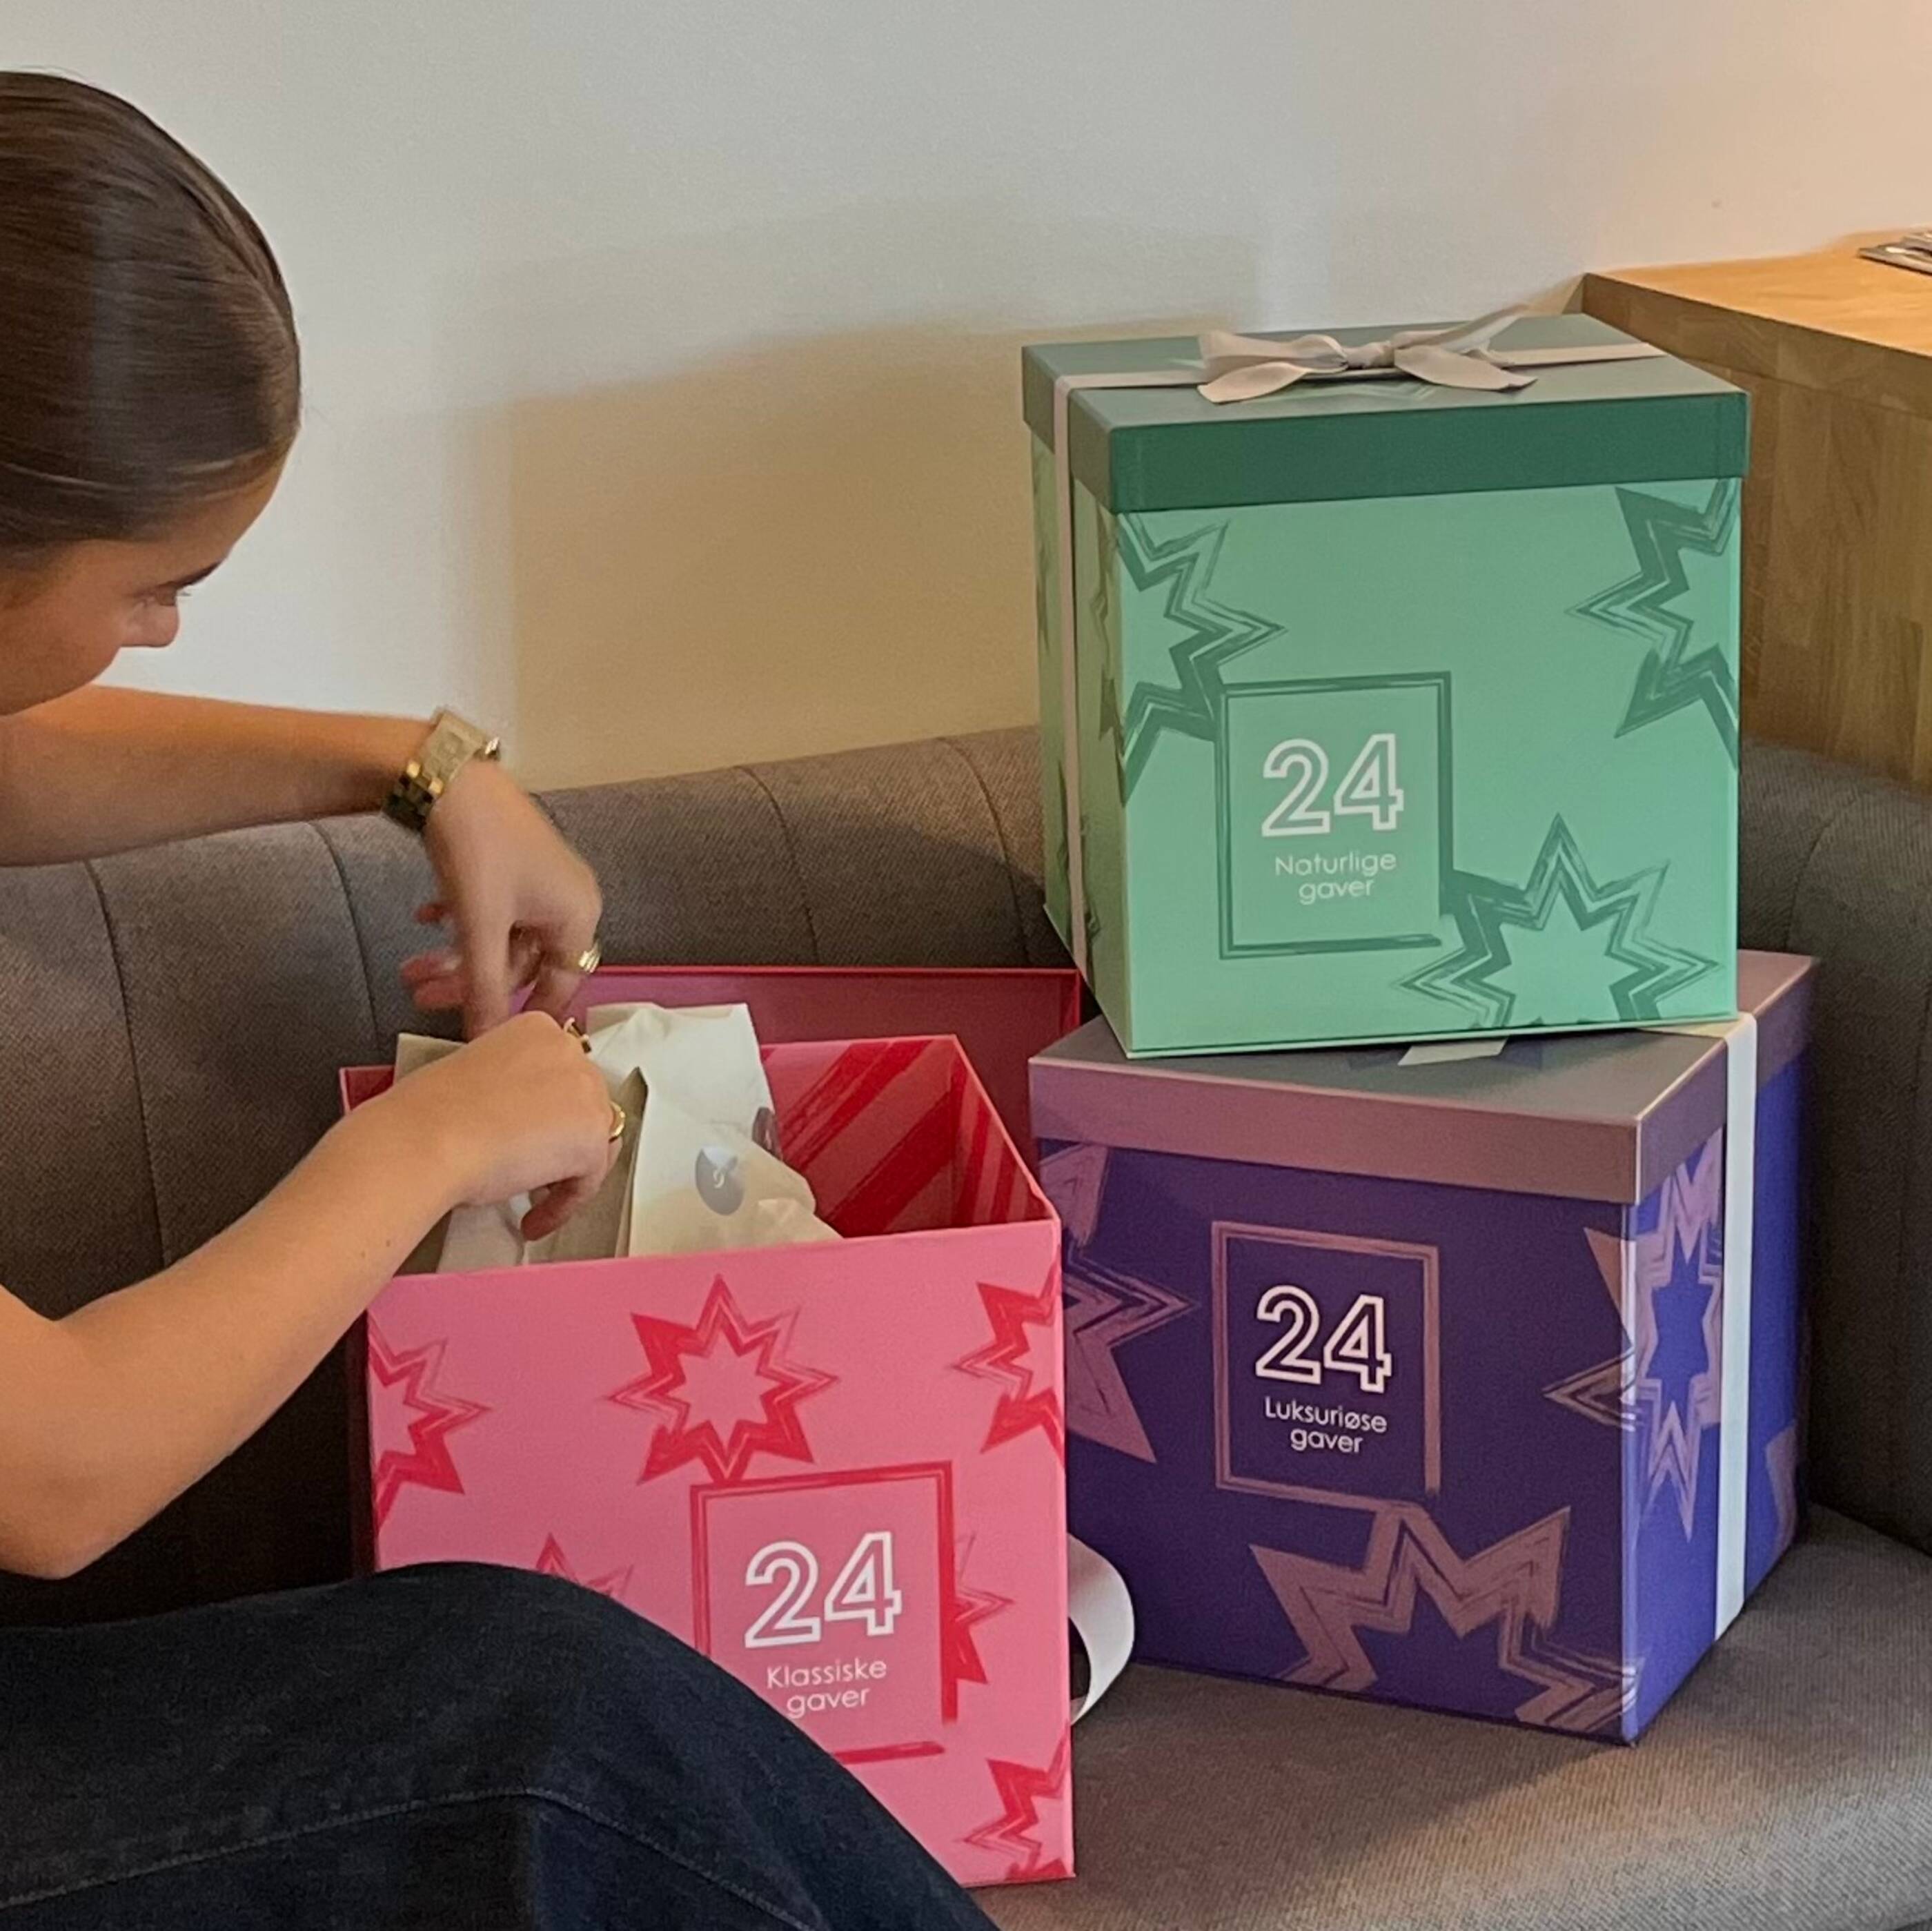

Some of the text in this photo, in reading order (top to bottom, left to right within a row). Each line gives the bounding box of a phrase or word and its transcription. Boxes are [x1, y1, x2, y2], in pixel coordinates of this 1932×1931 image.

[1261, 733, 1404, 837] 24
[1275, 852, 1397, 877] Naturlige
[1299, 879, 1375, 905] gaver
[1255, 1284, 1392, 1393] 24
[1264, 1396, 1388, 1433] Luksuriøse
[1290, 1428, 1363, 1453] gaver
[745, 1531, 903, 1648] 24
[767, 1658, 887, 1689] Klassiske
[786, 1688, 870, 1719] gaver
